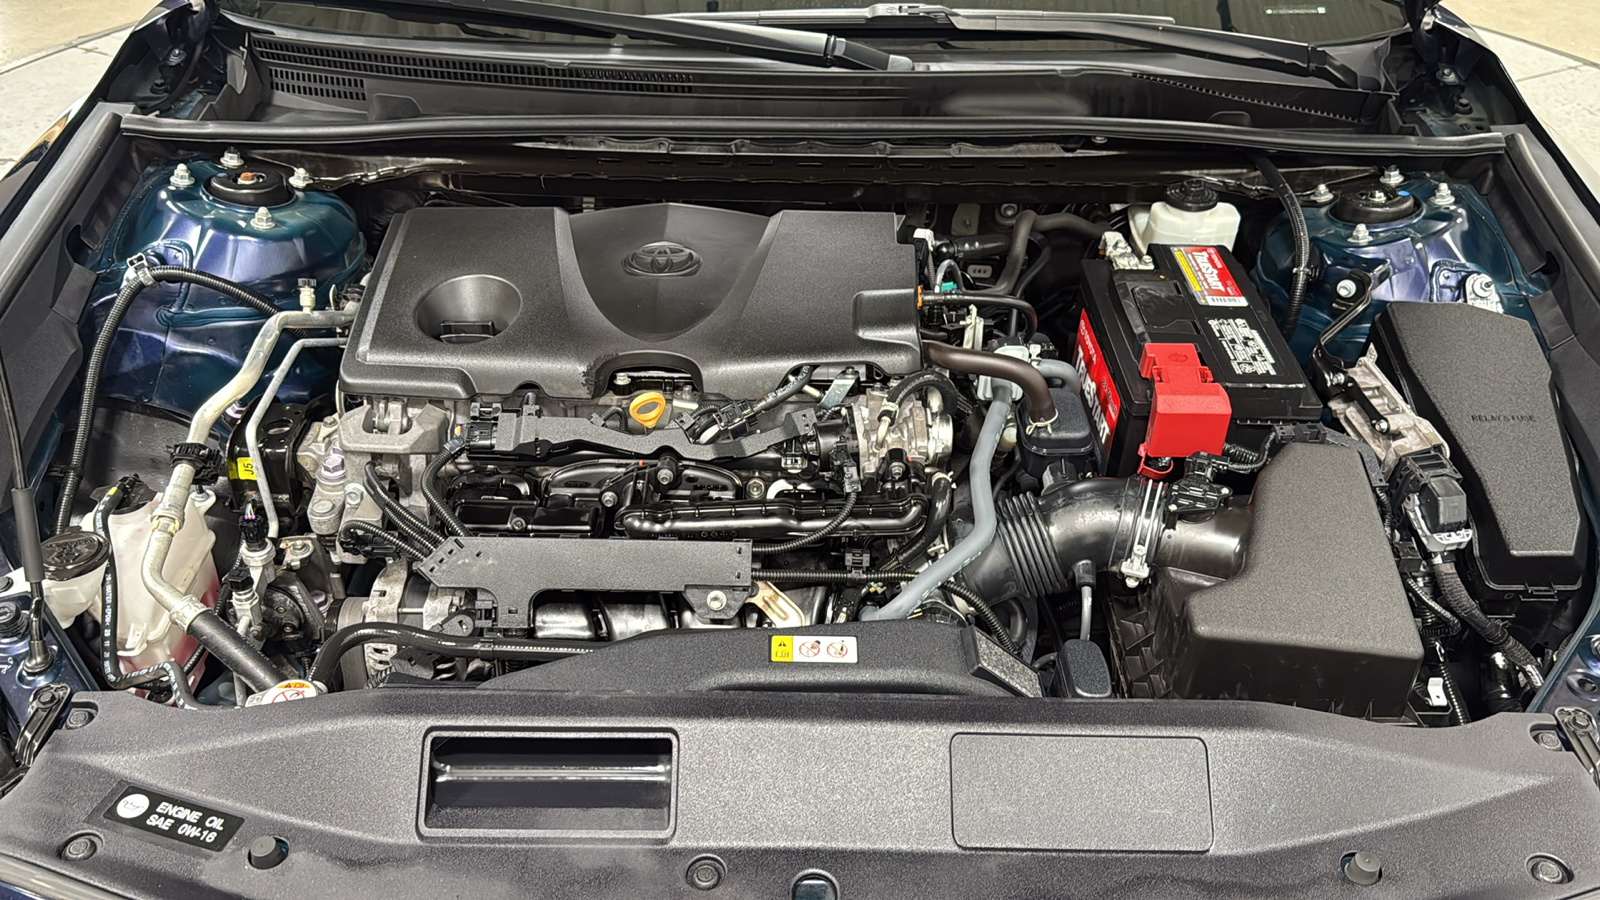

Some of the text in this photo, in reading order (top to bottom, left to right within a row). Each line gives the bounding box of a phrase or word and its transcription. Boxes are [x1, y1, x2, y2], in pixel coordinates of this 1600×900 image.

[1471, 414, 1502, 422] RELAY
[1511, 414, 1536, 422] FUSE
[243, 463, 255, 475] J5
[155, 801, 225, 831] ENGINE OIL
[146, 813, 218, 844] SAE 0W-16
